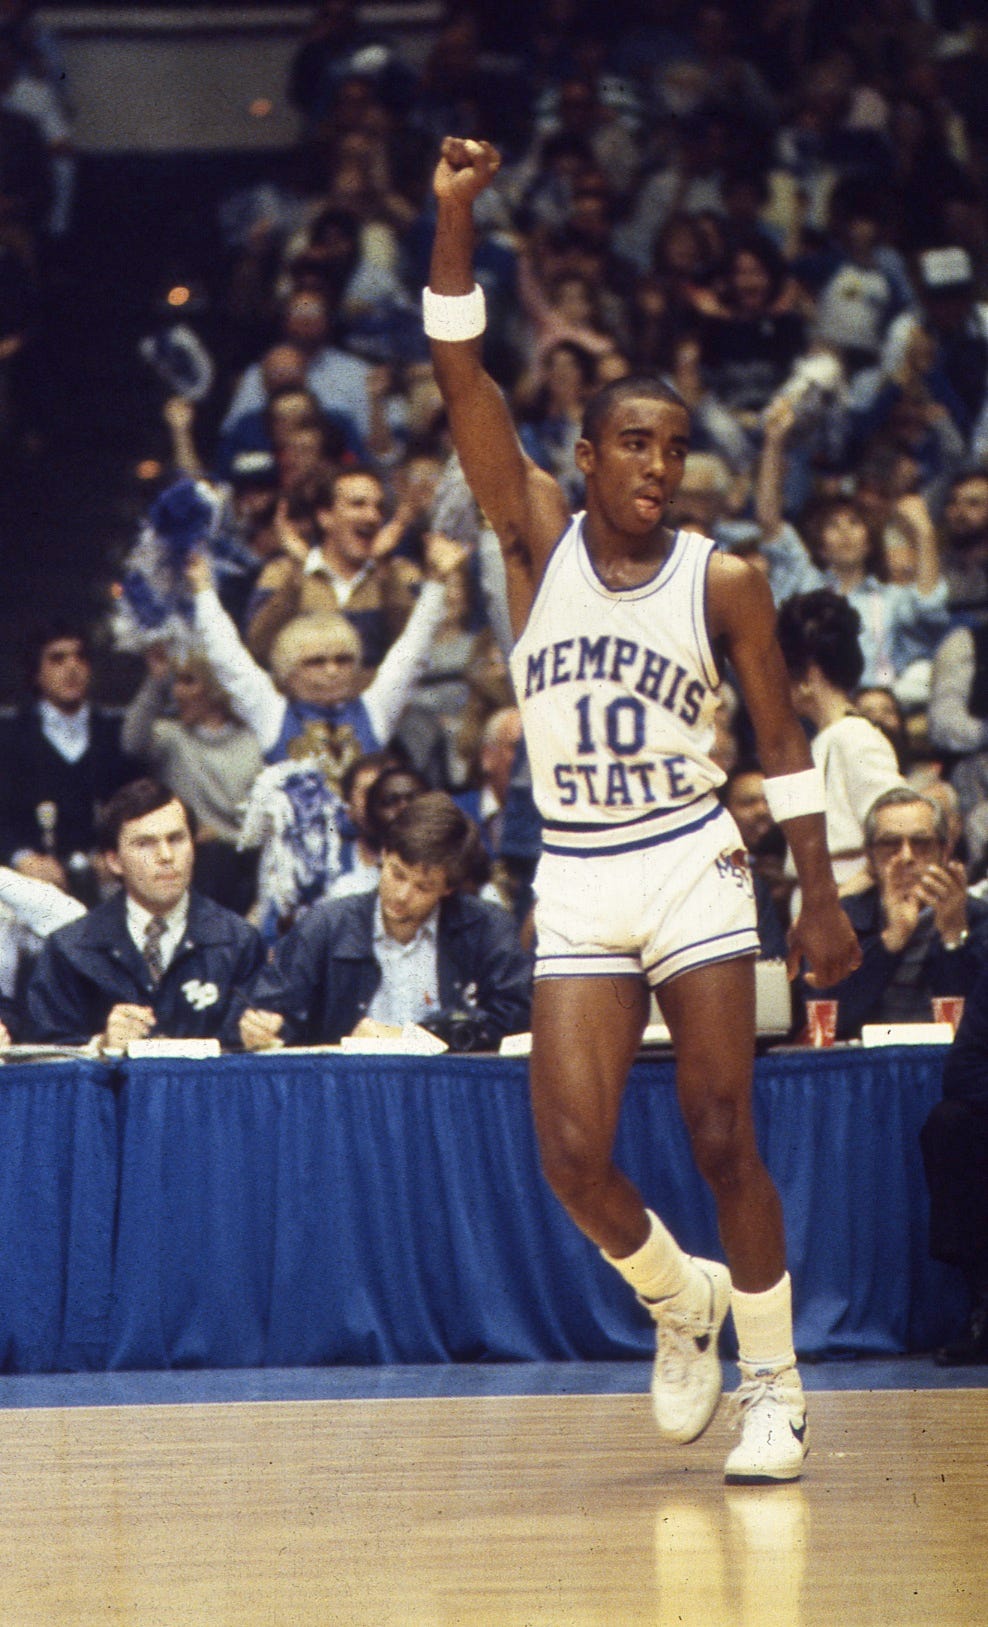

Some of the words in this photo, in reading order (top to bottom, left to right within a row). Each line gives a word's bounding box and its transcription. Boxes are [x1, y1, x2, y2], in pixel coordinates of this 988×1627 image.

[524, 635, 706, 727] MEMPHIS
[575, 693, 646, 756] 10
[553, 755, 695, 806] STATE
